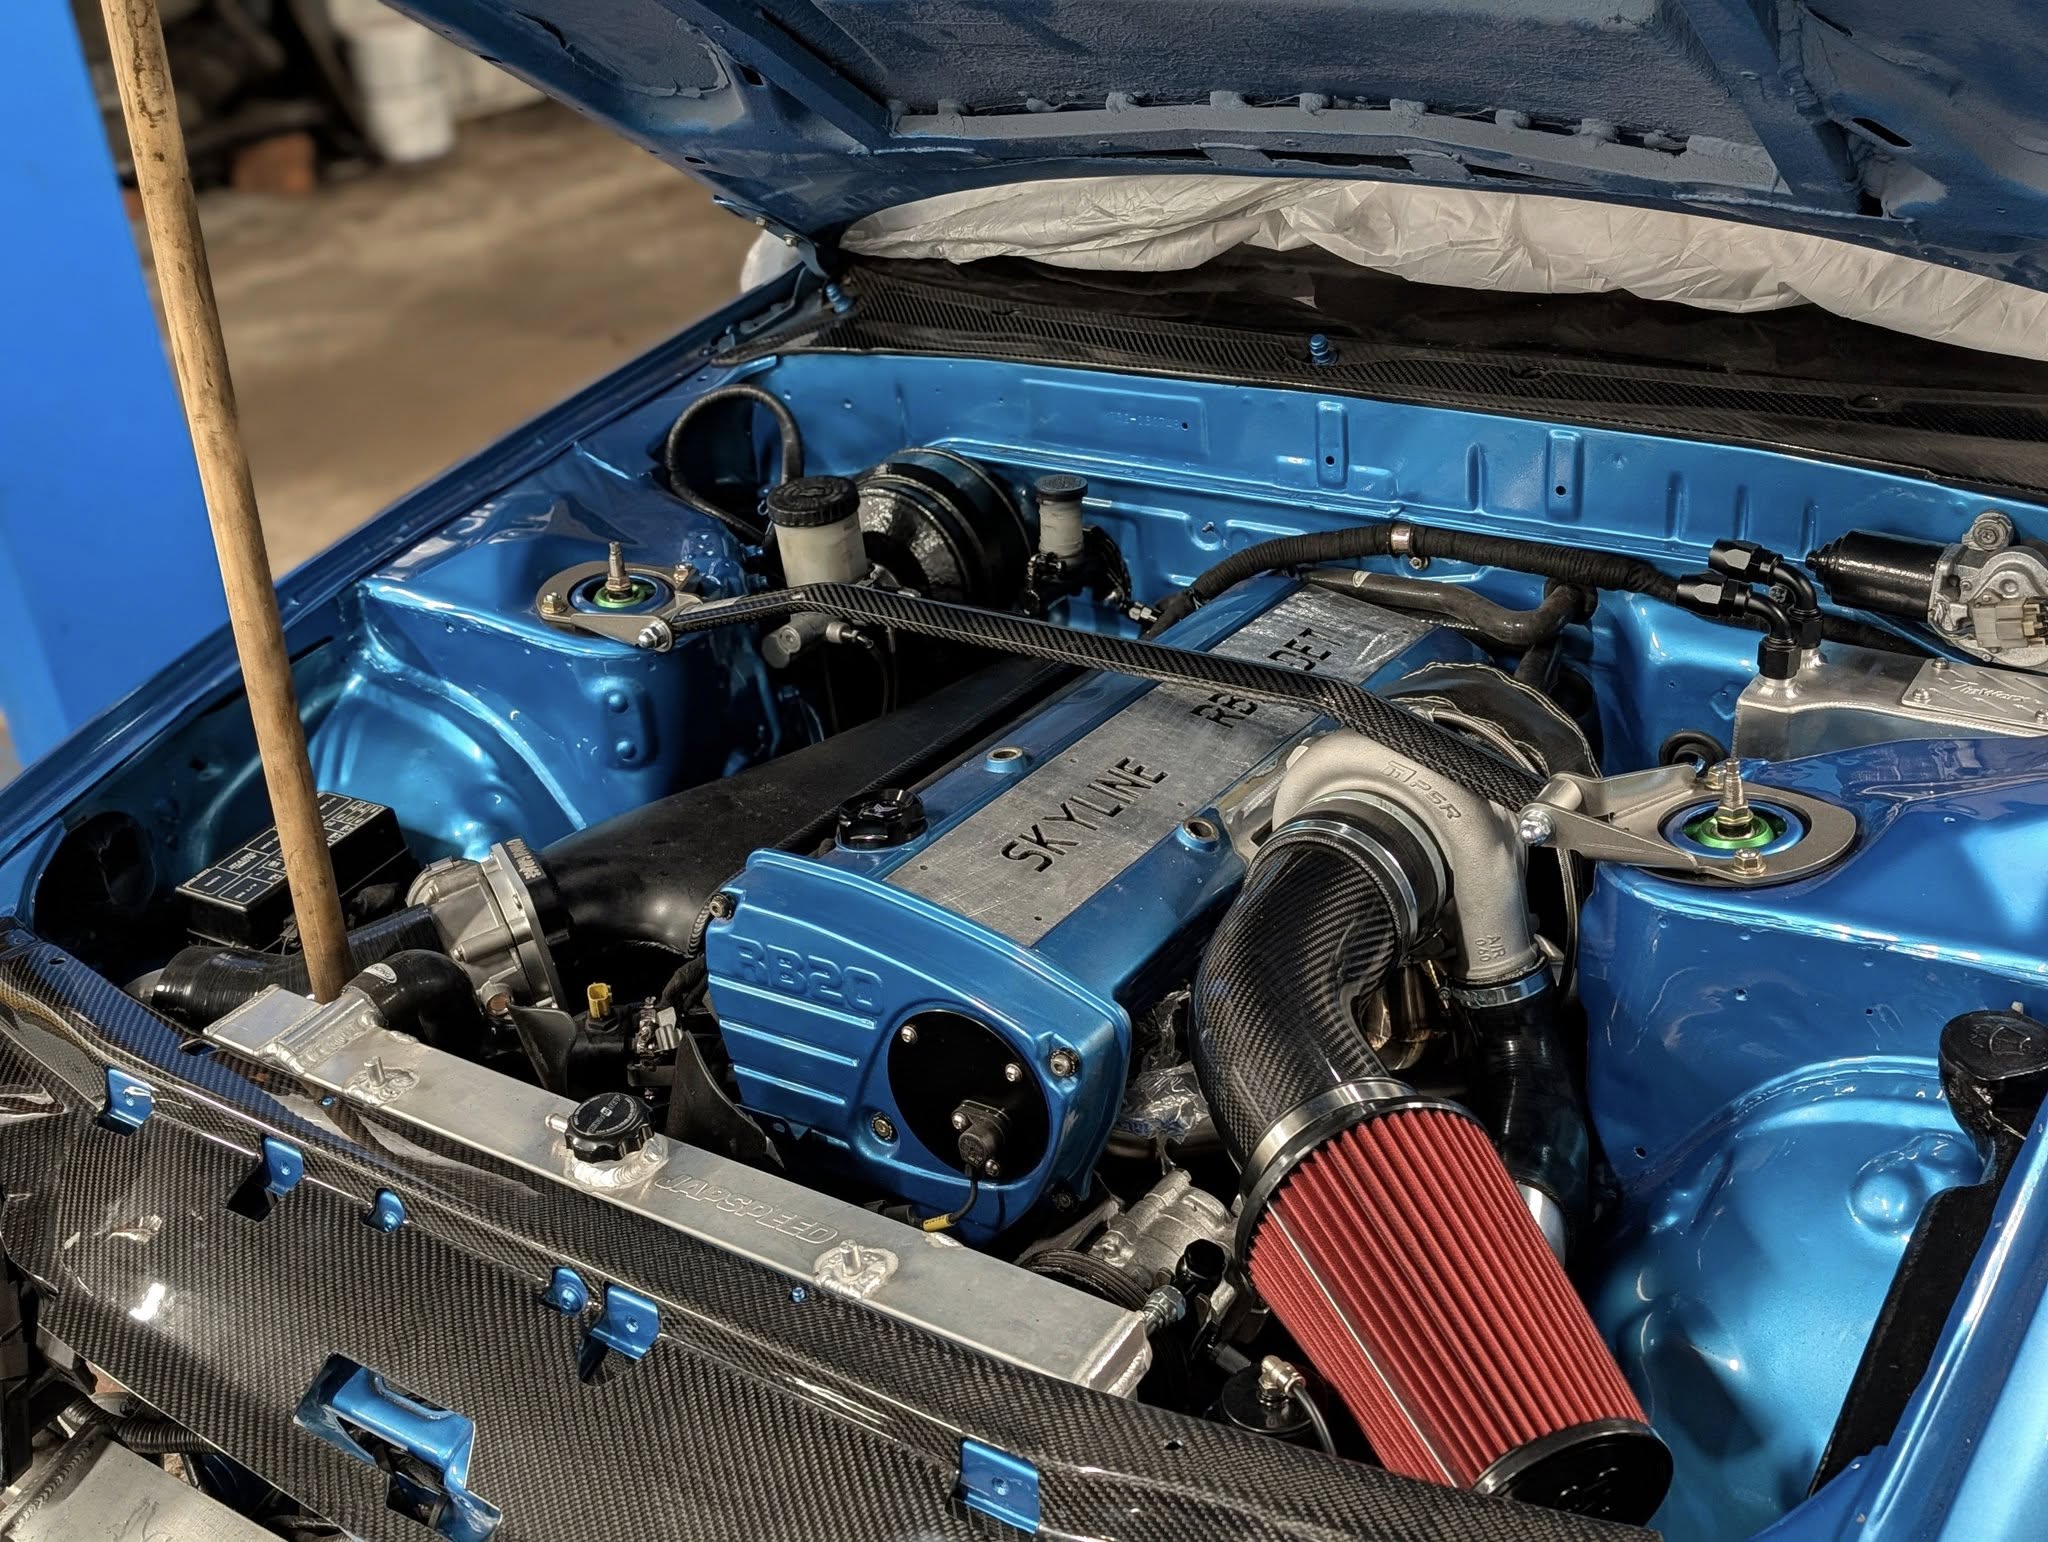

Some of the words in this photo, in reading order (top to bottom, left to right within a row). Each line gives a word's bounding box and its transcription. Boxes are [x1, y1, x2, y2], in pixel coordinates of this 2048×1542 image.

[1000, 756, 1169, 873] SKYLINE
[1409, 779, 1462, 819] PSR
[729, 933, 884, 1015] RB20
[654, 1174, 839, 1244] JAPSPEED
